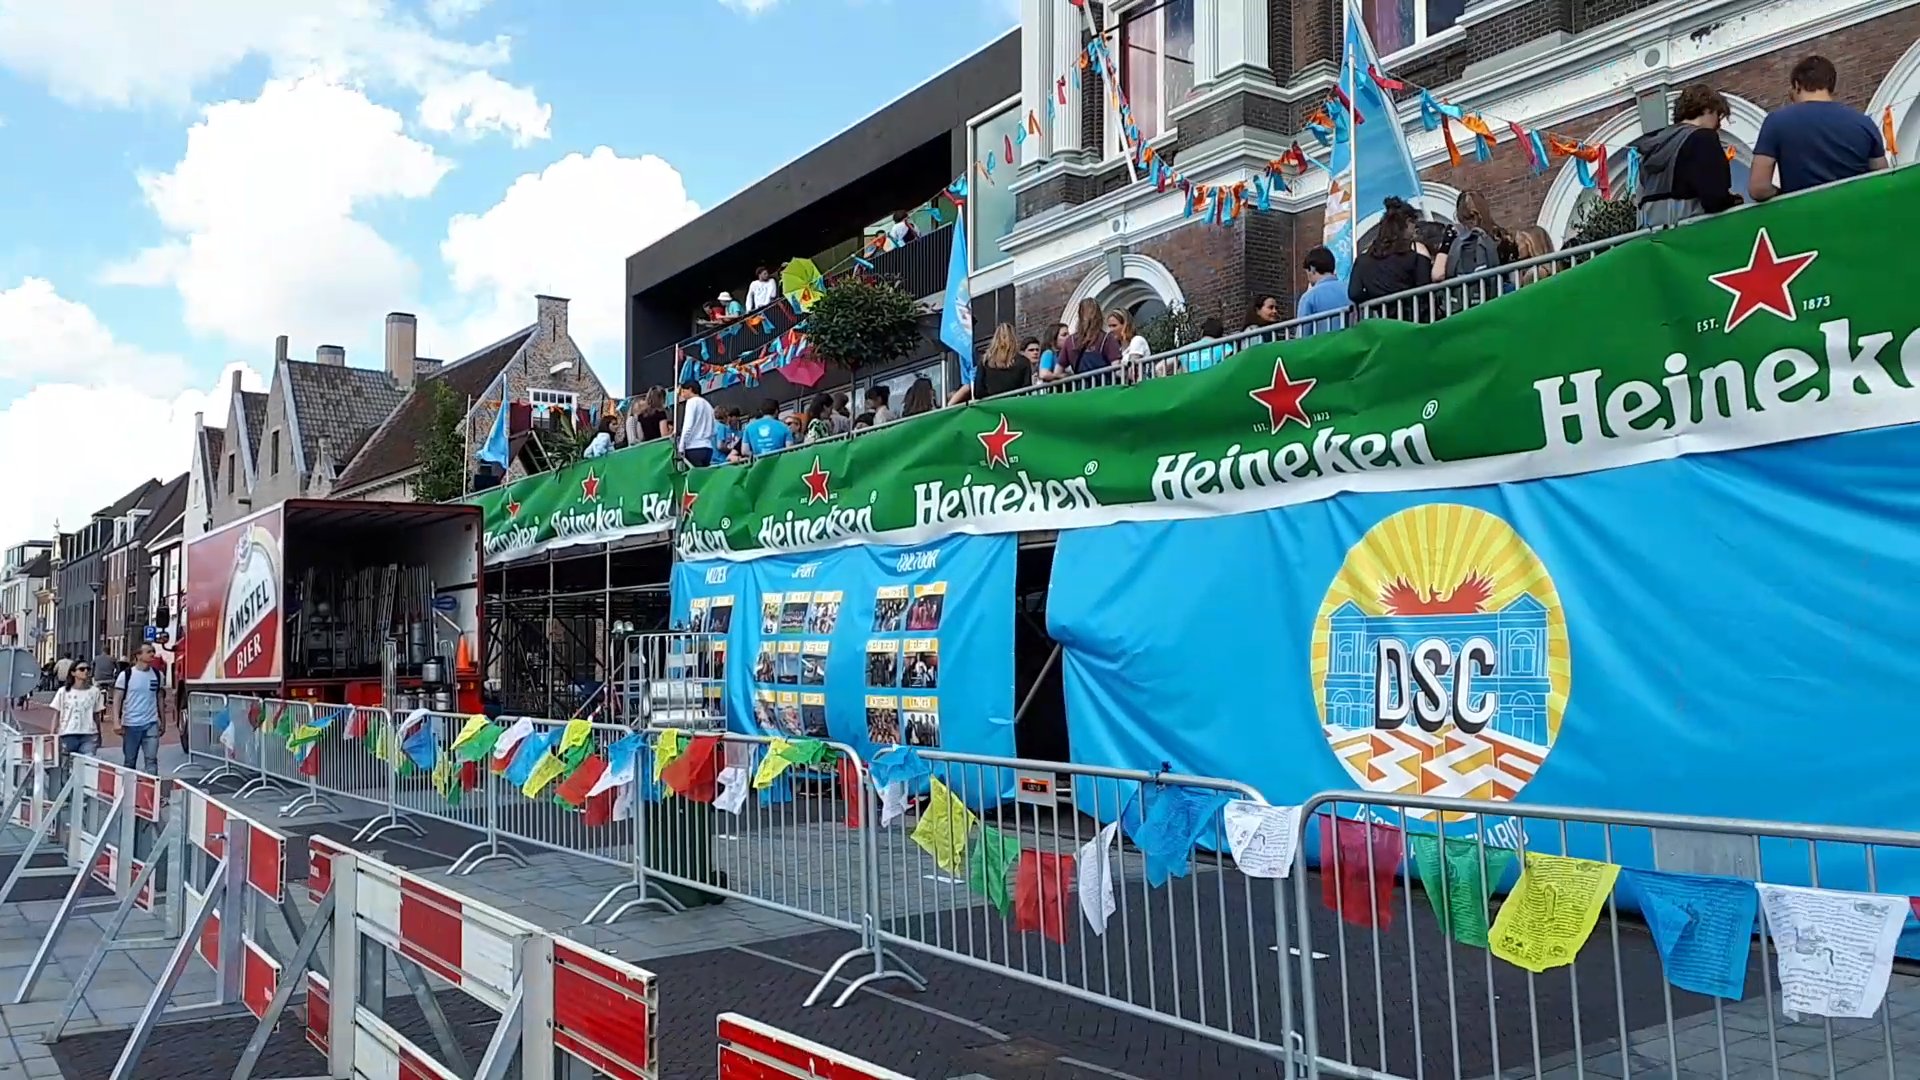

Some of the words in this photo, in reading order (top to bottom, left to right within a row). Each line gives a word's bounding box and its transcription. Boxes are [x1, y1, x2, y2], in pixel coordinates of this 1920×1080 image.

[1696, 318, 1719, 333] EST.
[1802, 295, 1831, 311] 1873
[1152, 422, 1442, 502] Heineken
[551, 502, 625, 539] Heineken
[912, 471, 1102, 526] Heineken
[758, 504, 876, 549] Heineken
[227, 579, 270, 649] AMSTEL
[236, 632, 262, 677] BIER
[1375, 637, 1498, 735] DSC
